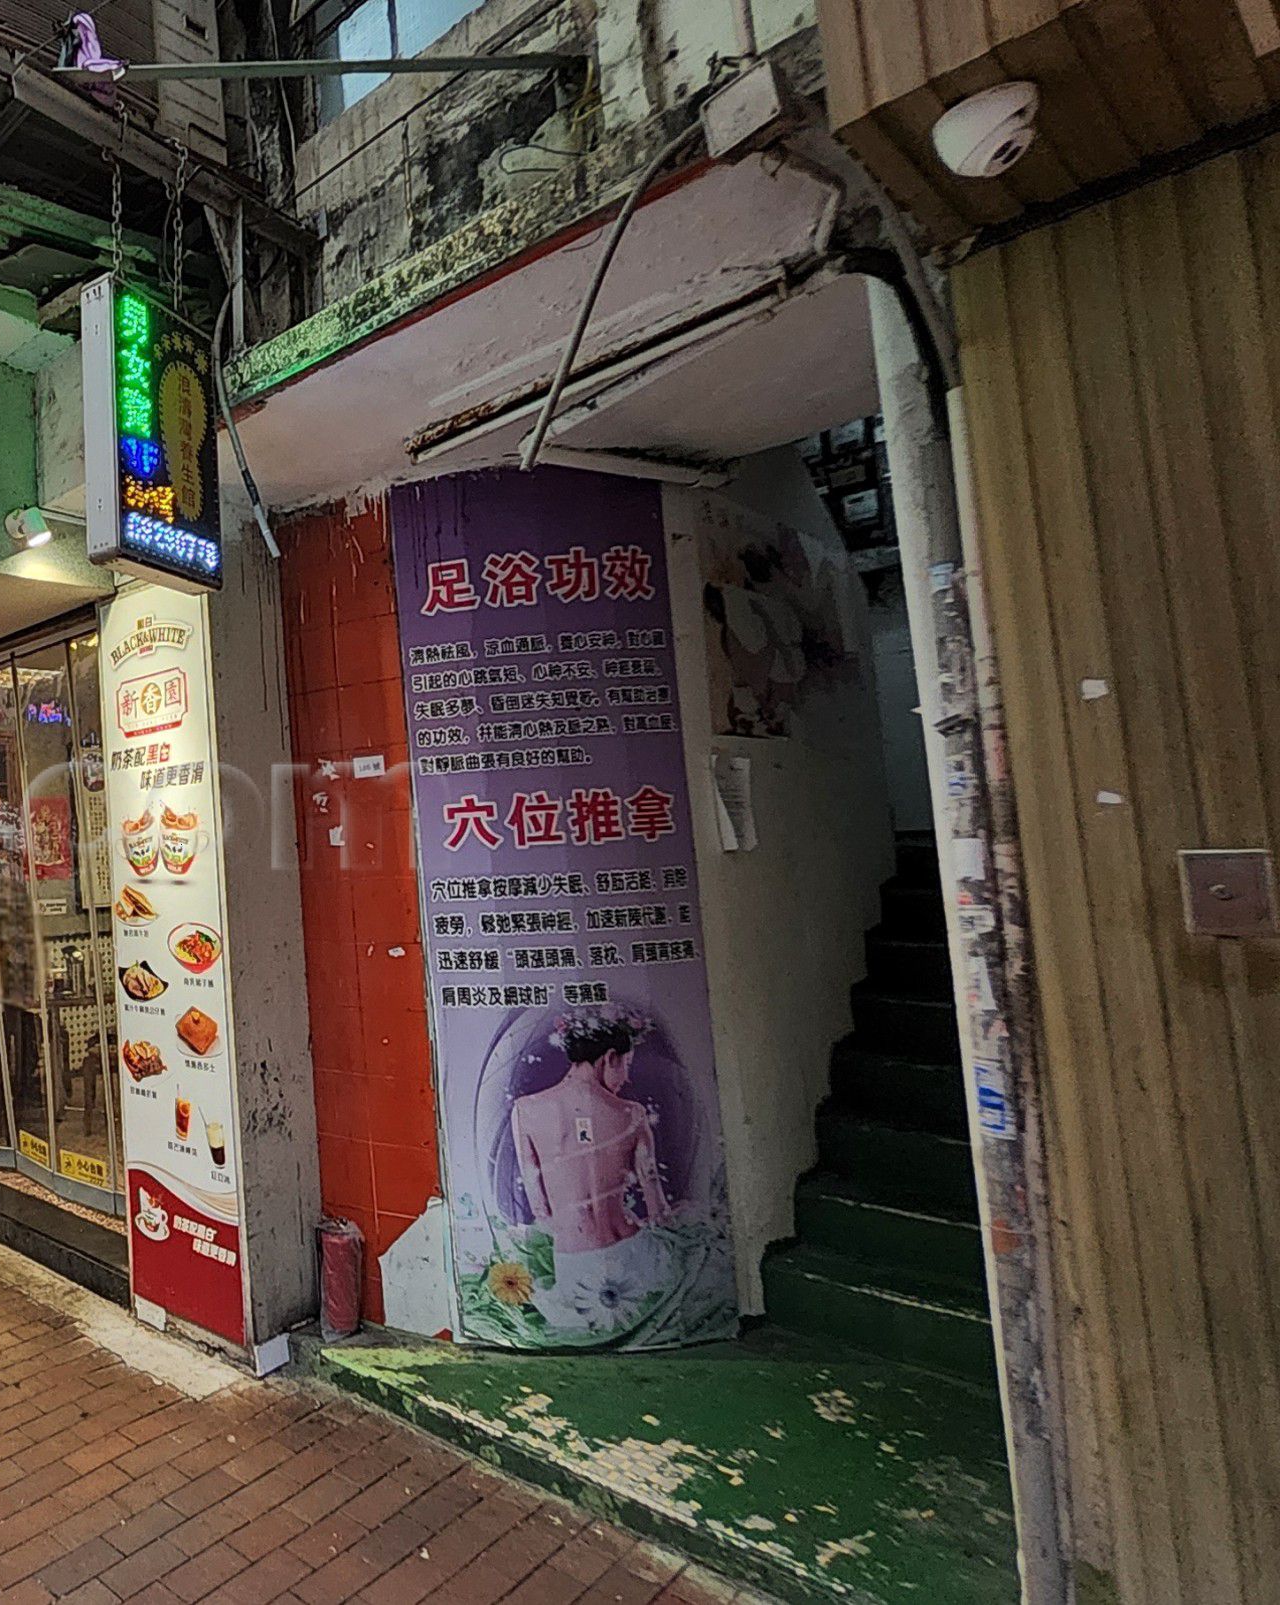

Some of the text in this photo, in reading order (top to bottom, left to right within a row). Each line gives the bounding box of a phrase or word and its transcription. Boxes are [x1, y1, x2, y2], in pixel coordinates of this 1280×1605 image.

[422, 546, 655, 616] 足浴功效
[111, 627, 186, 665] BLACK&WHITE
[121, 677, 182, 720] 新香園
[111, 743, 172, 772] 奶茶配黑白
[139, 761, 205, 790] 味道更香滑
[443, 785, 675, 851] 穴位推拿
